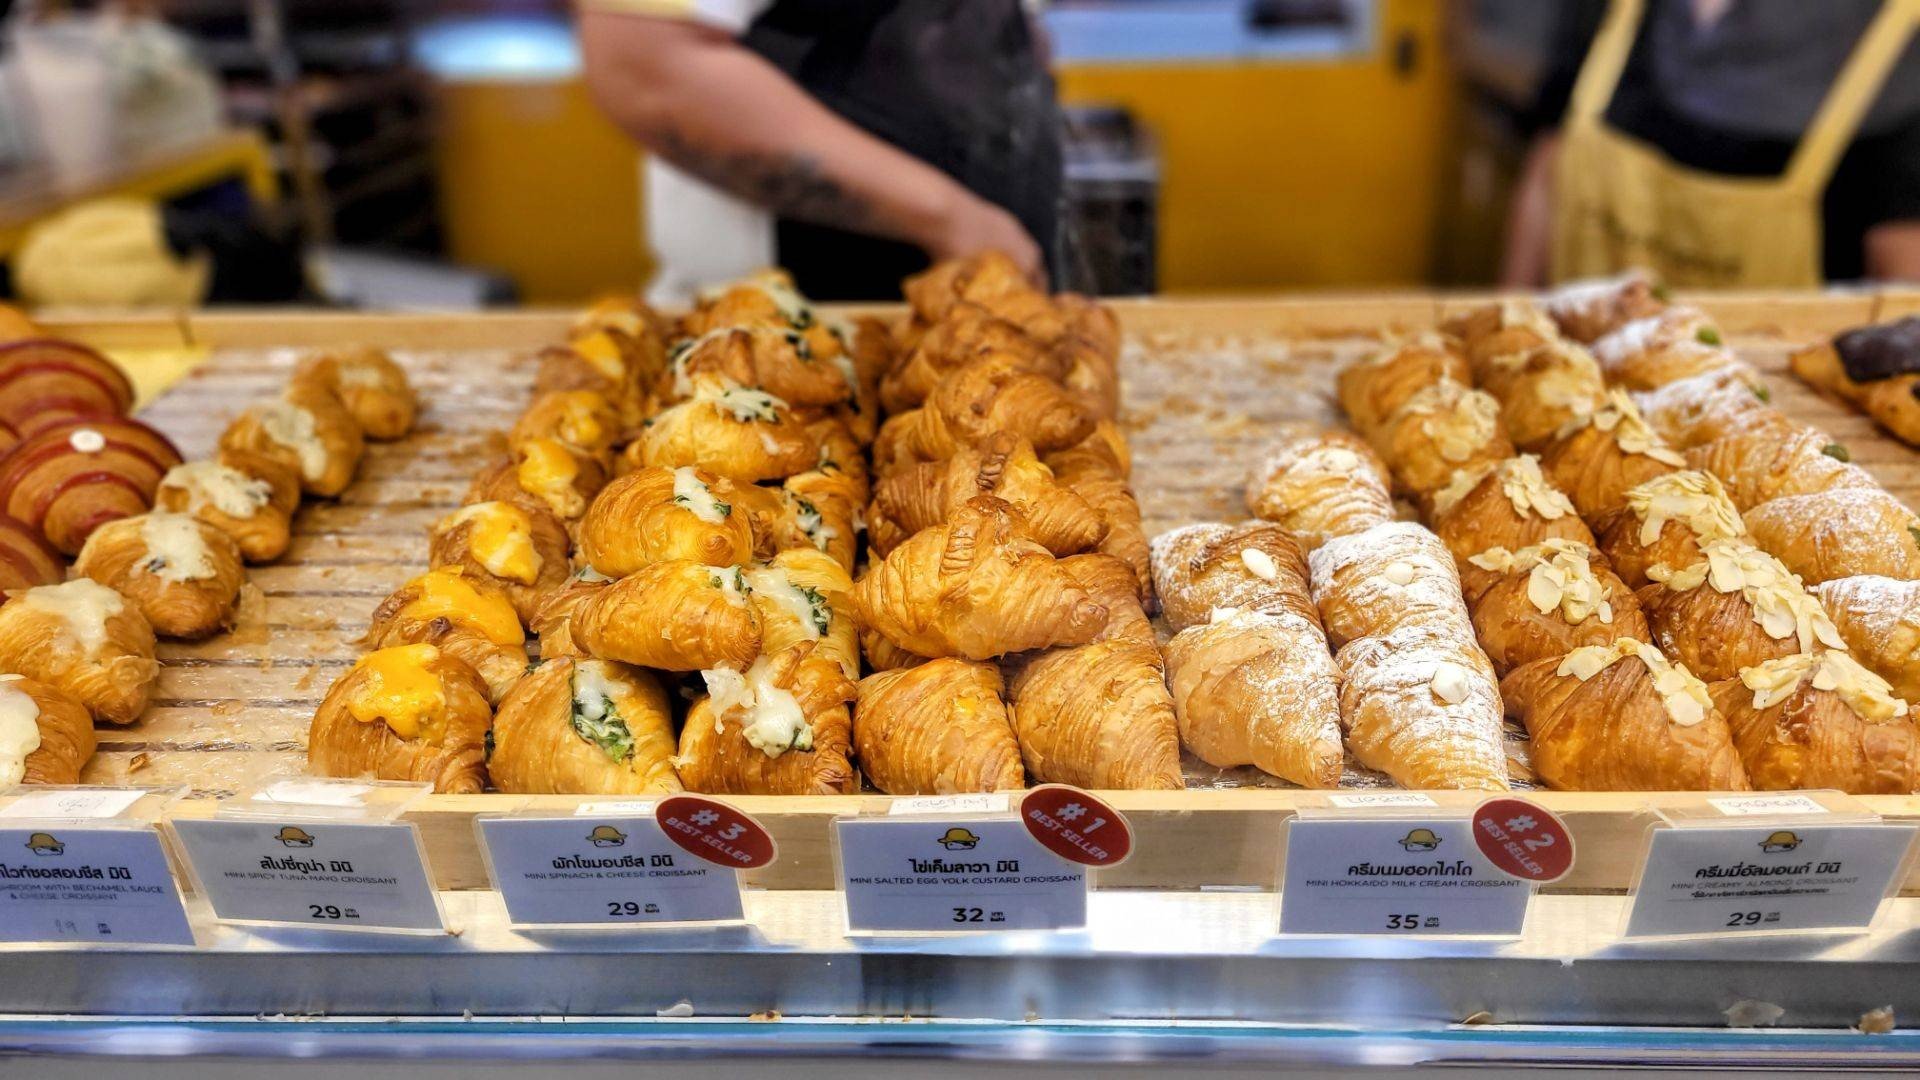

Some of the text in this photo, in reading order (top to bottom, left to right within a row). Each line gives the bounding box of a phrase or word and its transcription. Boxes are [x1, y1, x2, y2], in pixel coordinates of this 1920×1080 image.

[666, 817, 752, 863] BEST SELLER
[1029, 809, 1108, 860] BEST SELLER
[1480, 818, 1543, 875] BEST SELLER
[552, 854, 645, 869] ผักโขมอบชีส
[908, 858, 990, 873] ไข่เค็มลาวา
[1348, 861, 1473, 876] ครีมนมฮอกไกโด
[524, 872, 546, 880] MINI
[548, 871, 594, 880] SPINACH
[606, 870, 646, 879] CHEESE
[648, 869, 707, 878] CROISSANT
[1695, 861, 1813, 879] ครีมมี่อัลมอนด์
[224, 871, 398, 885] MINI SPICY TUNA MAYO CROISSANT
[850, 874, 1082, 885] MINI SALTED EGG YOLK CUSTARD CROISSANT
[1306, 879, 1521, 888] MINI HOKKAIDO MILK CREAM CROISSANT
[129, 885, 164, 894] SAUCE
[309, 904, 341, 919] 29
[607, 901, 640, 916] 29
[952, 907, 984, 922] 32
[1386, 914, 1419, 929] 35
[1726, 911, 1762, 926] 29
